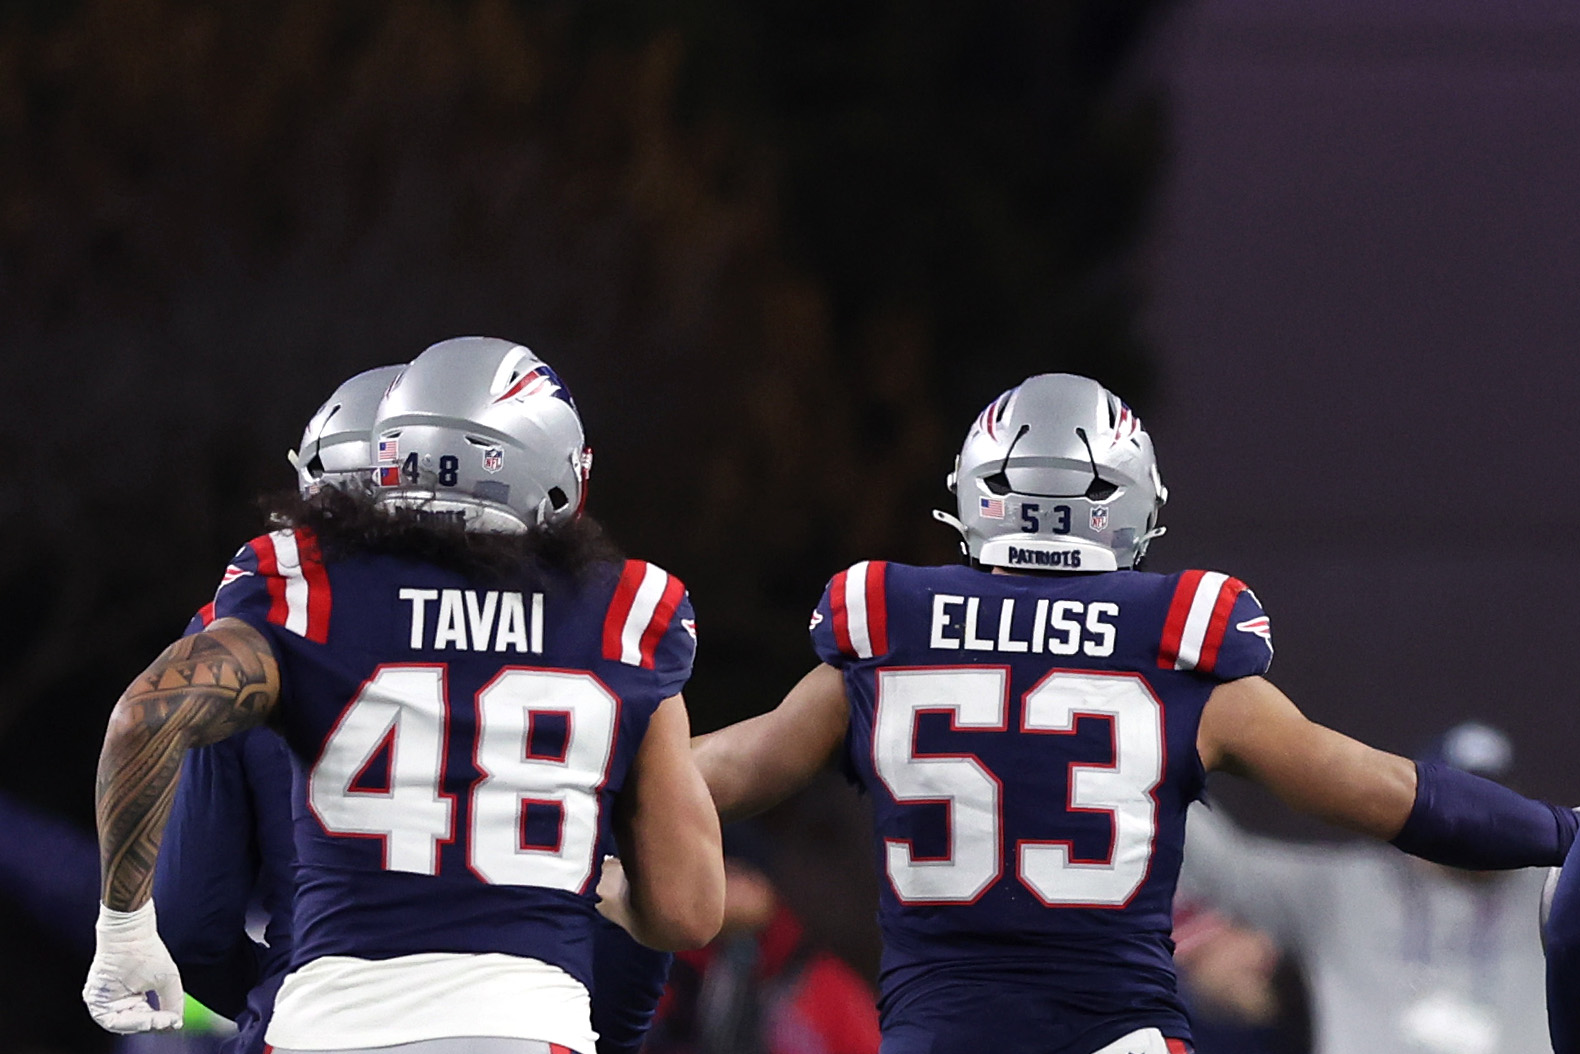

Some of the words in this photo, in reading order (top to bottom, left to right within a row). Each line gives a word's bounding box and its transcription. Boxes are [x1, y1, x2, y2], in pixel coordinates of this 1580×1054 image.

[1008, 546, 1081, 567] PATRIOTS
[399, 589, 543, 653] TAVAI
[930, 595, 1119, 656] ELLISS
[309, 662, 621, 894] 48
[872, 664, 1165, 909] 53
